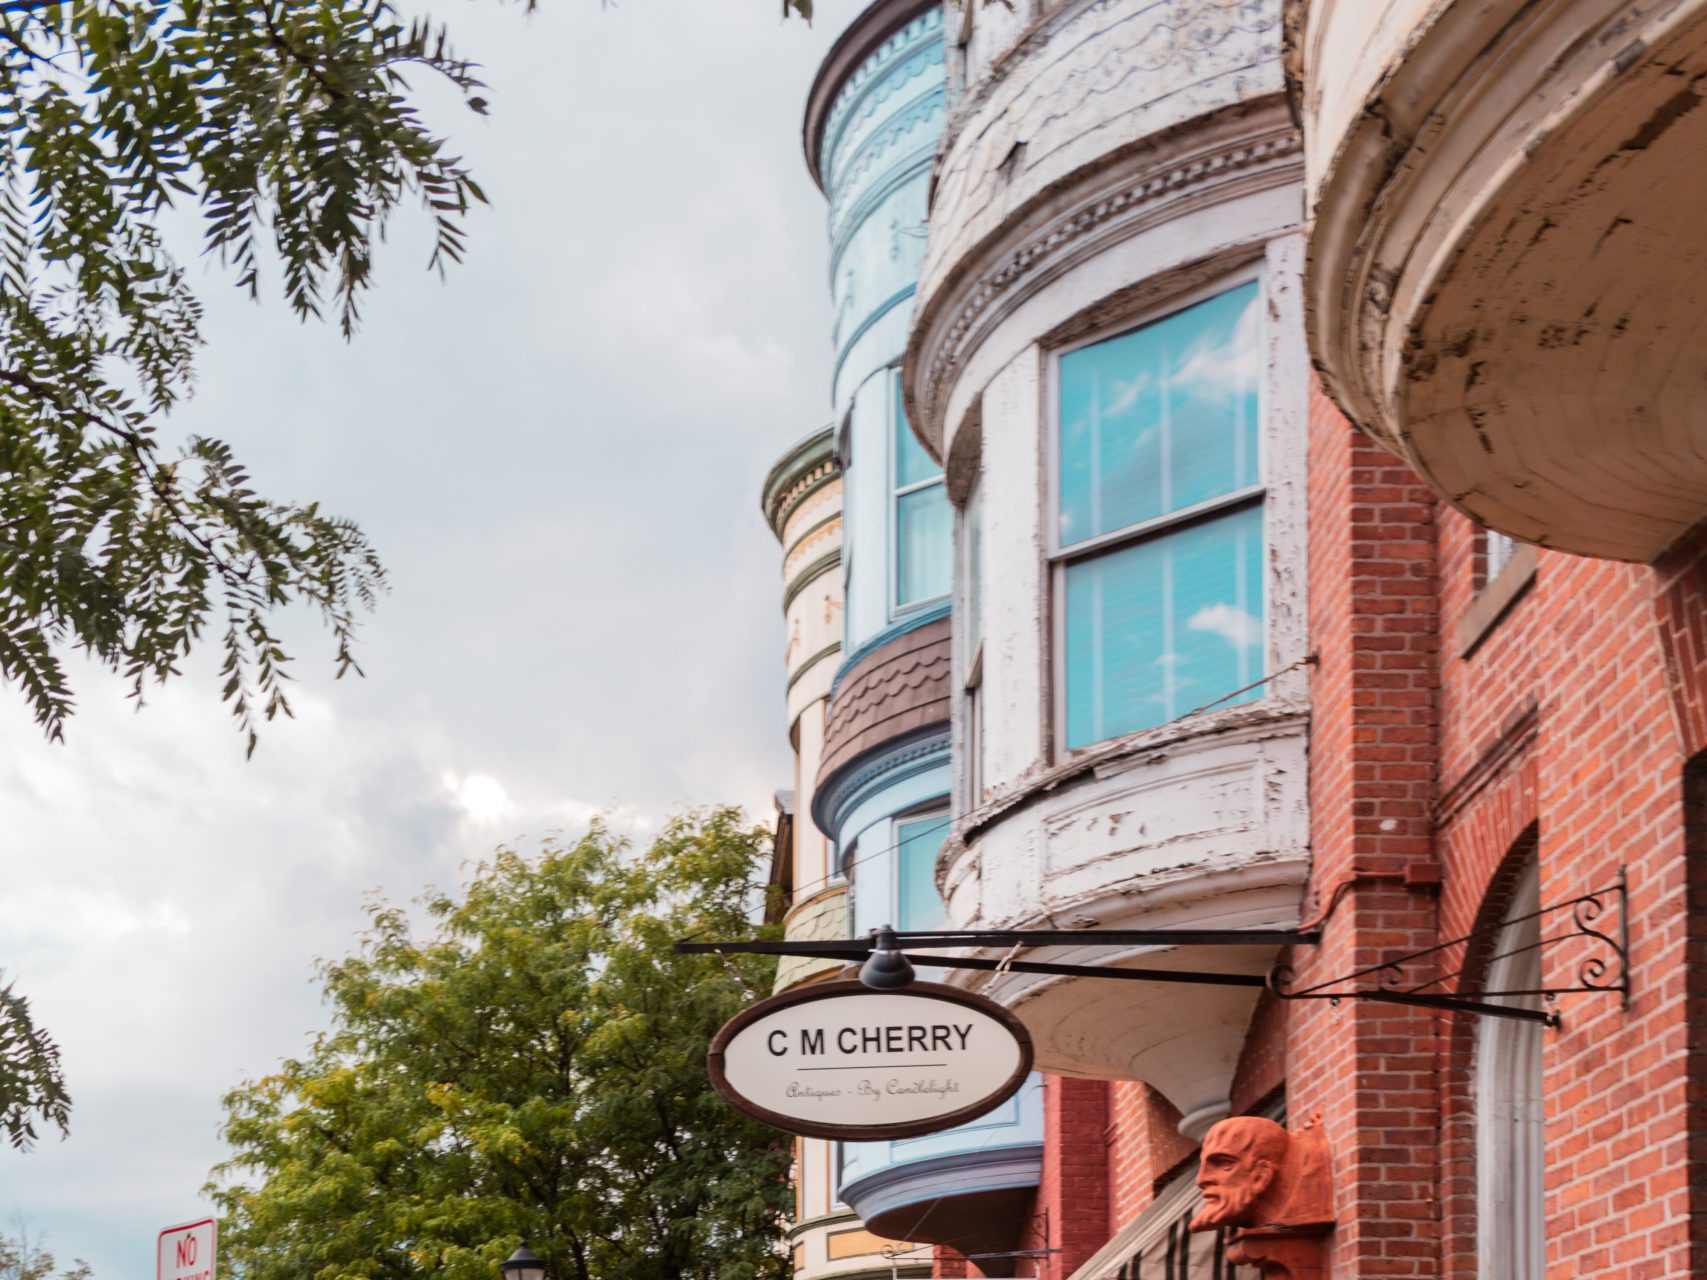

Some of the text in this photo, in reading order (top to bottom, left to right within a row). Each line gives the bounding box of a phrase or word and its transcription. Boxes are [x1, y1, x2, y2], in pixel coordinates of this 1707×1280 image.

[768, 1023, 974, 1056] C M CHERRY
[785, 1081, 842, 1100] Antiques
[857, 1079, 881, 1101] By
[176, 1237, 197, 1268] NO
